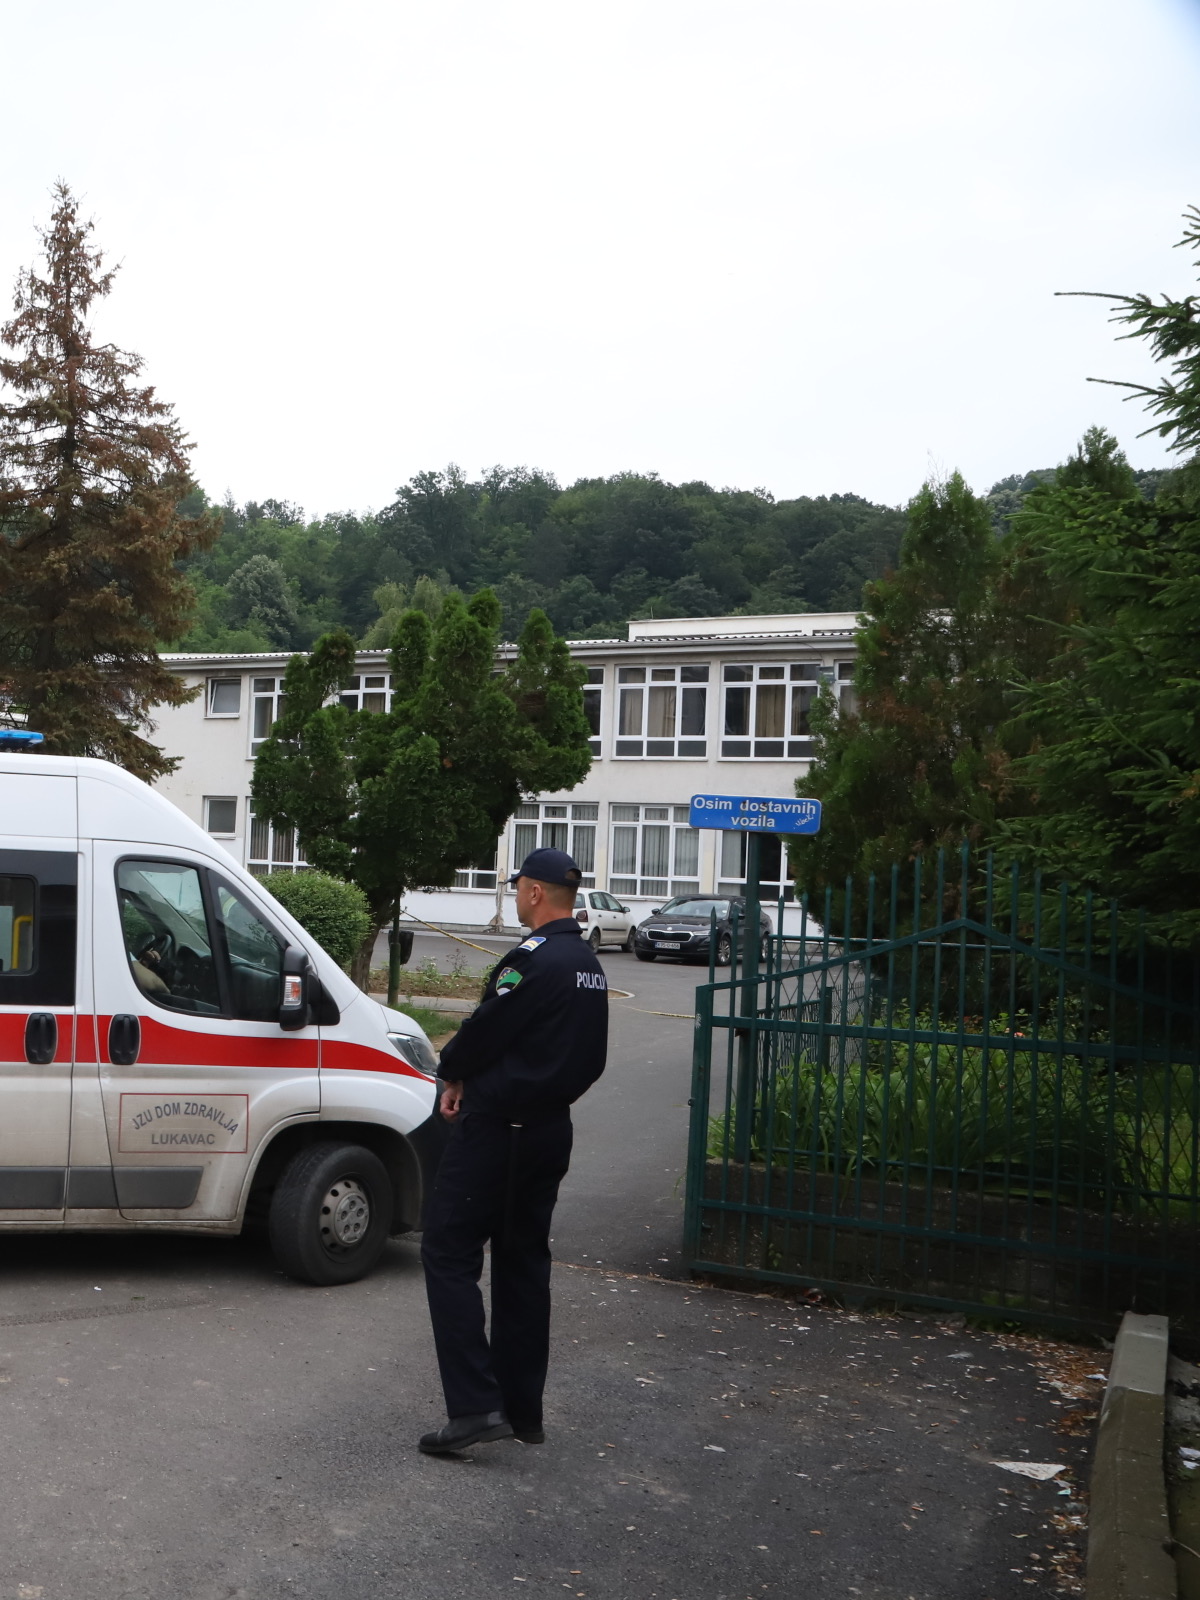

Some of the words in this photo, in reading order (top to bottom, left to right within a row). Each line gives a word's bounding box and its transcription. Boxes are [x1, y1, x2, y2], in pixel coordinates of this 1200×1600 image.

[693, 797, 733, 810] Osim
[740, 799, 816, 815] dostavnih
[731, 815, 775, 827] vozila
[132, 1109, 153, 1130] JZU
[155, 1102, 181, 1118] DOM
[184, 1102, 239, 1135] ZDRAVLJA
[151, 1133, 216, 1145] LUKAVAC
